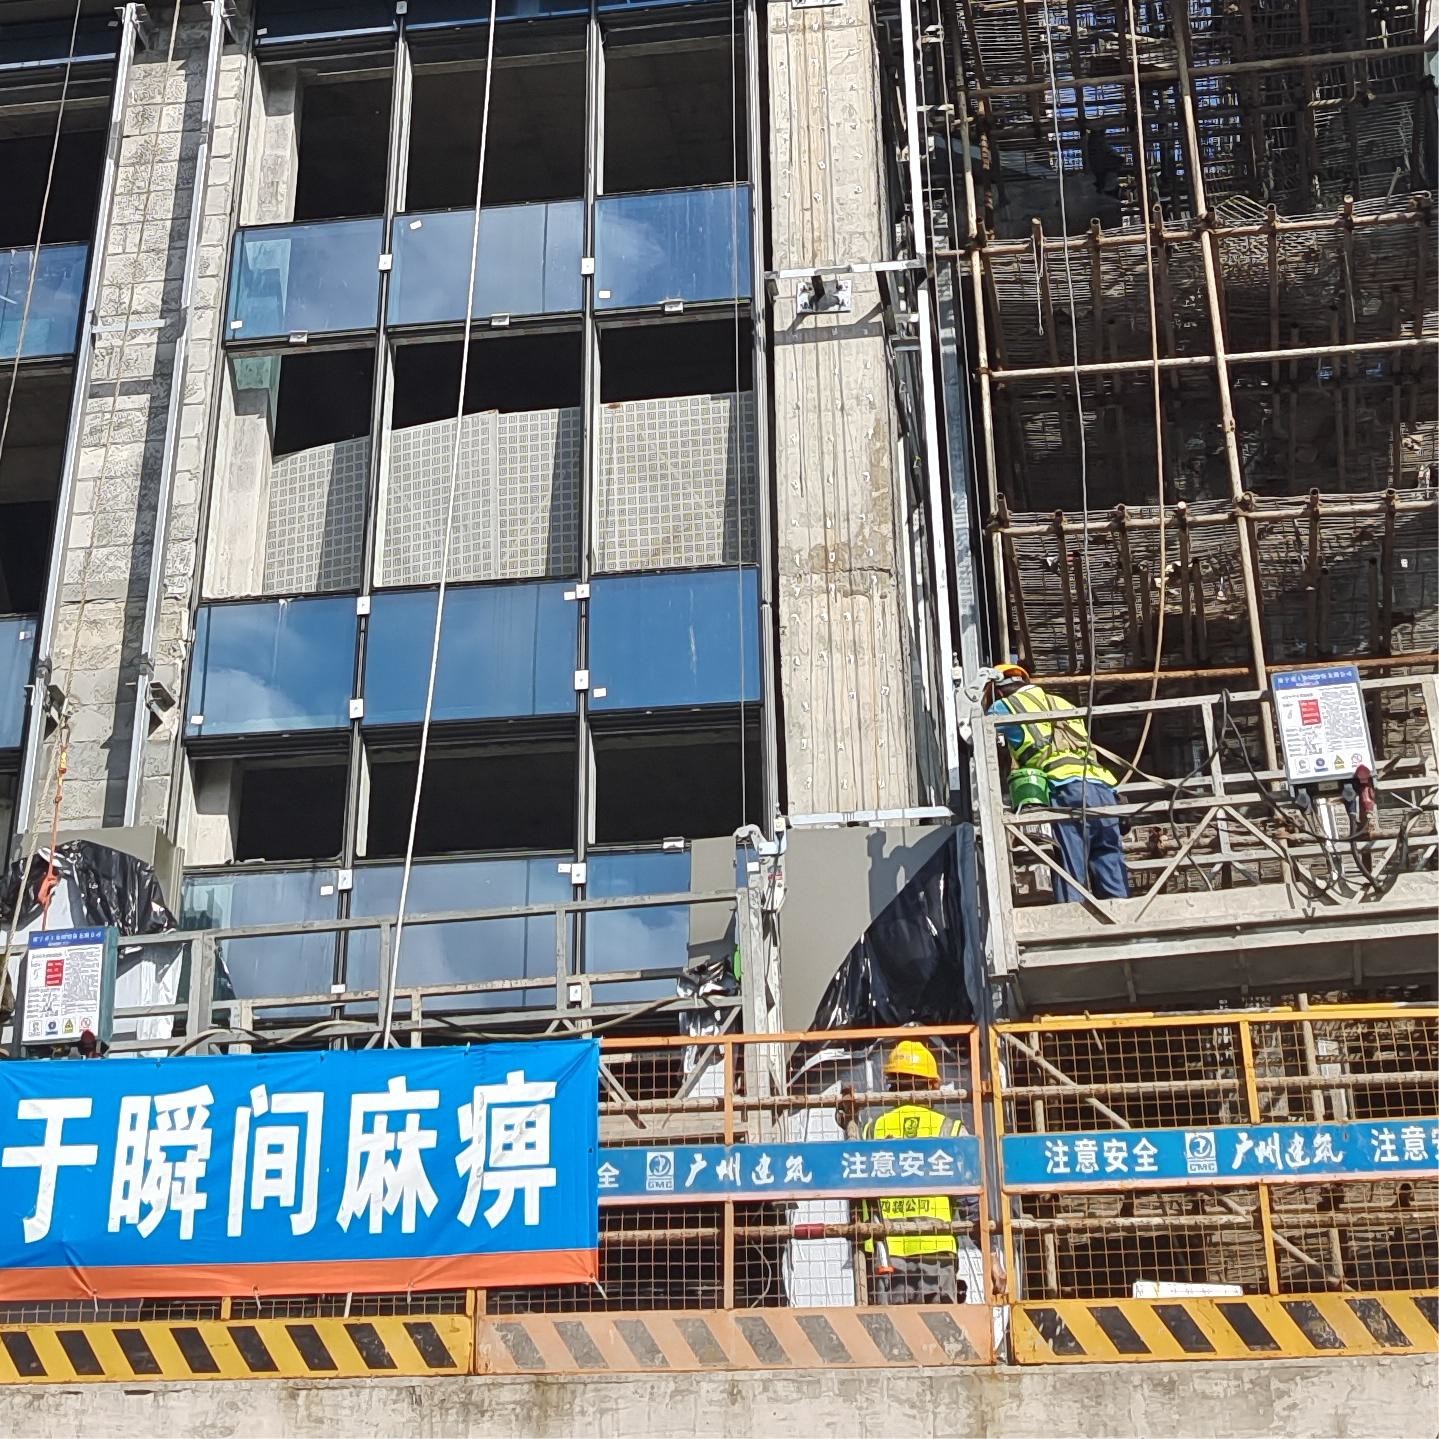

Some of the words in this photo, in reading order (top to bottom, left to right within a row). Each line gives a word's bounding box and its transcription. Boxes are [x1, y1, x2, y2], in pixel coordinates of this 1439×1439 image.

[1045, 1137, 1159, 1174] 注意安全
[1231, 1132, 1344, 1170] 广州建筑
[1370, 1125, 1439, 1163] 注意
[684, 1152, 813, 1187] 广州建筑
[841, 1149, 954, 1179] 注意安全
